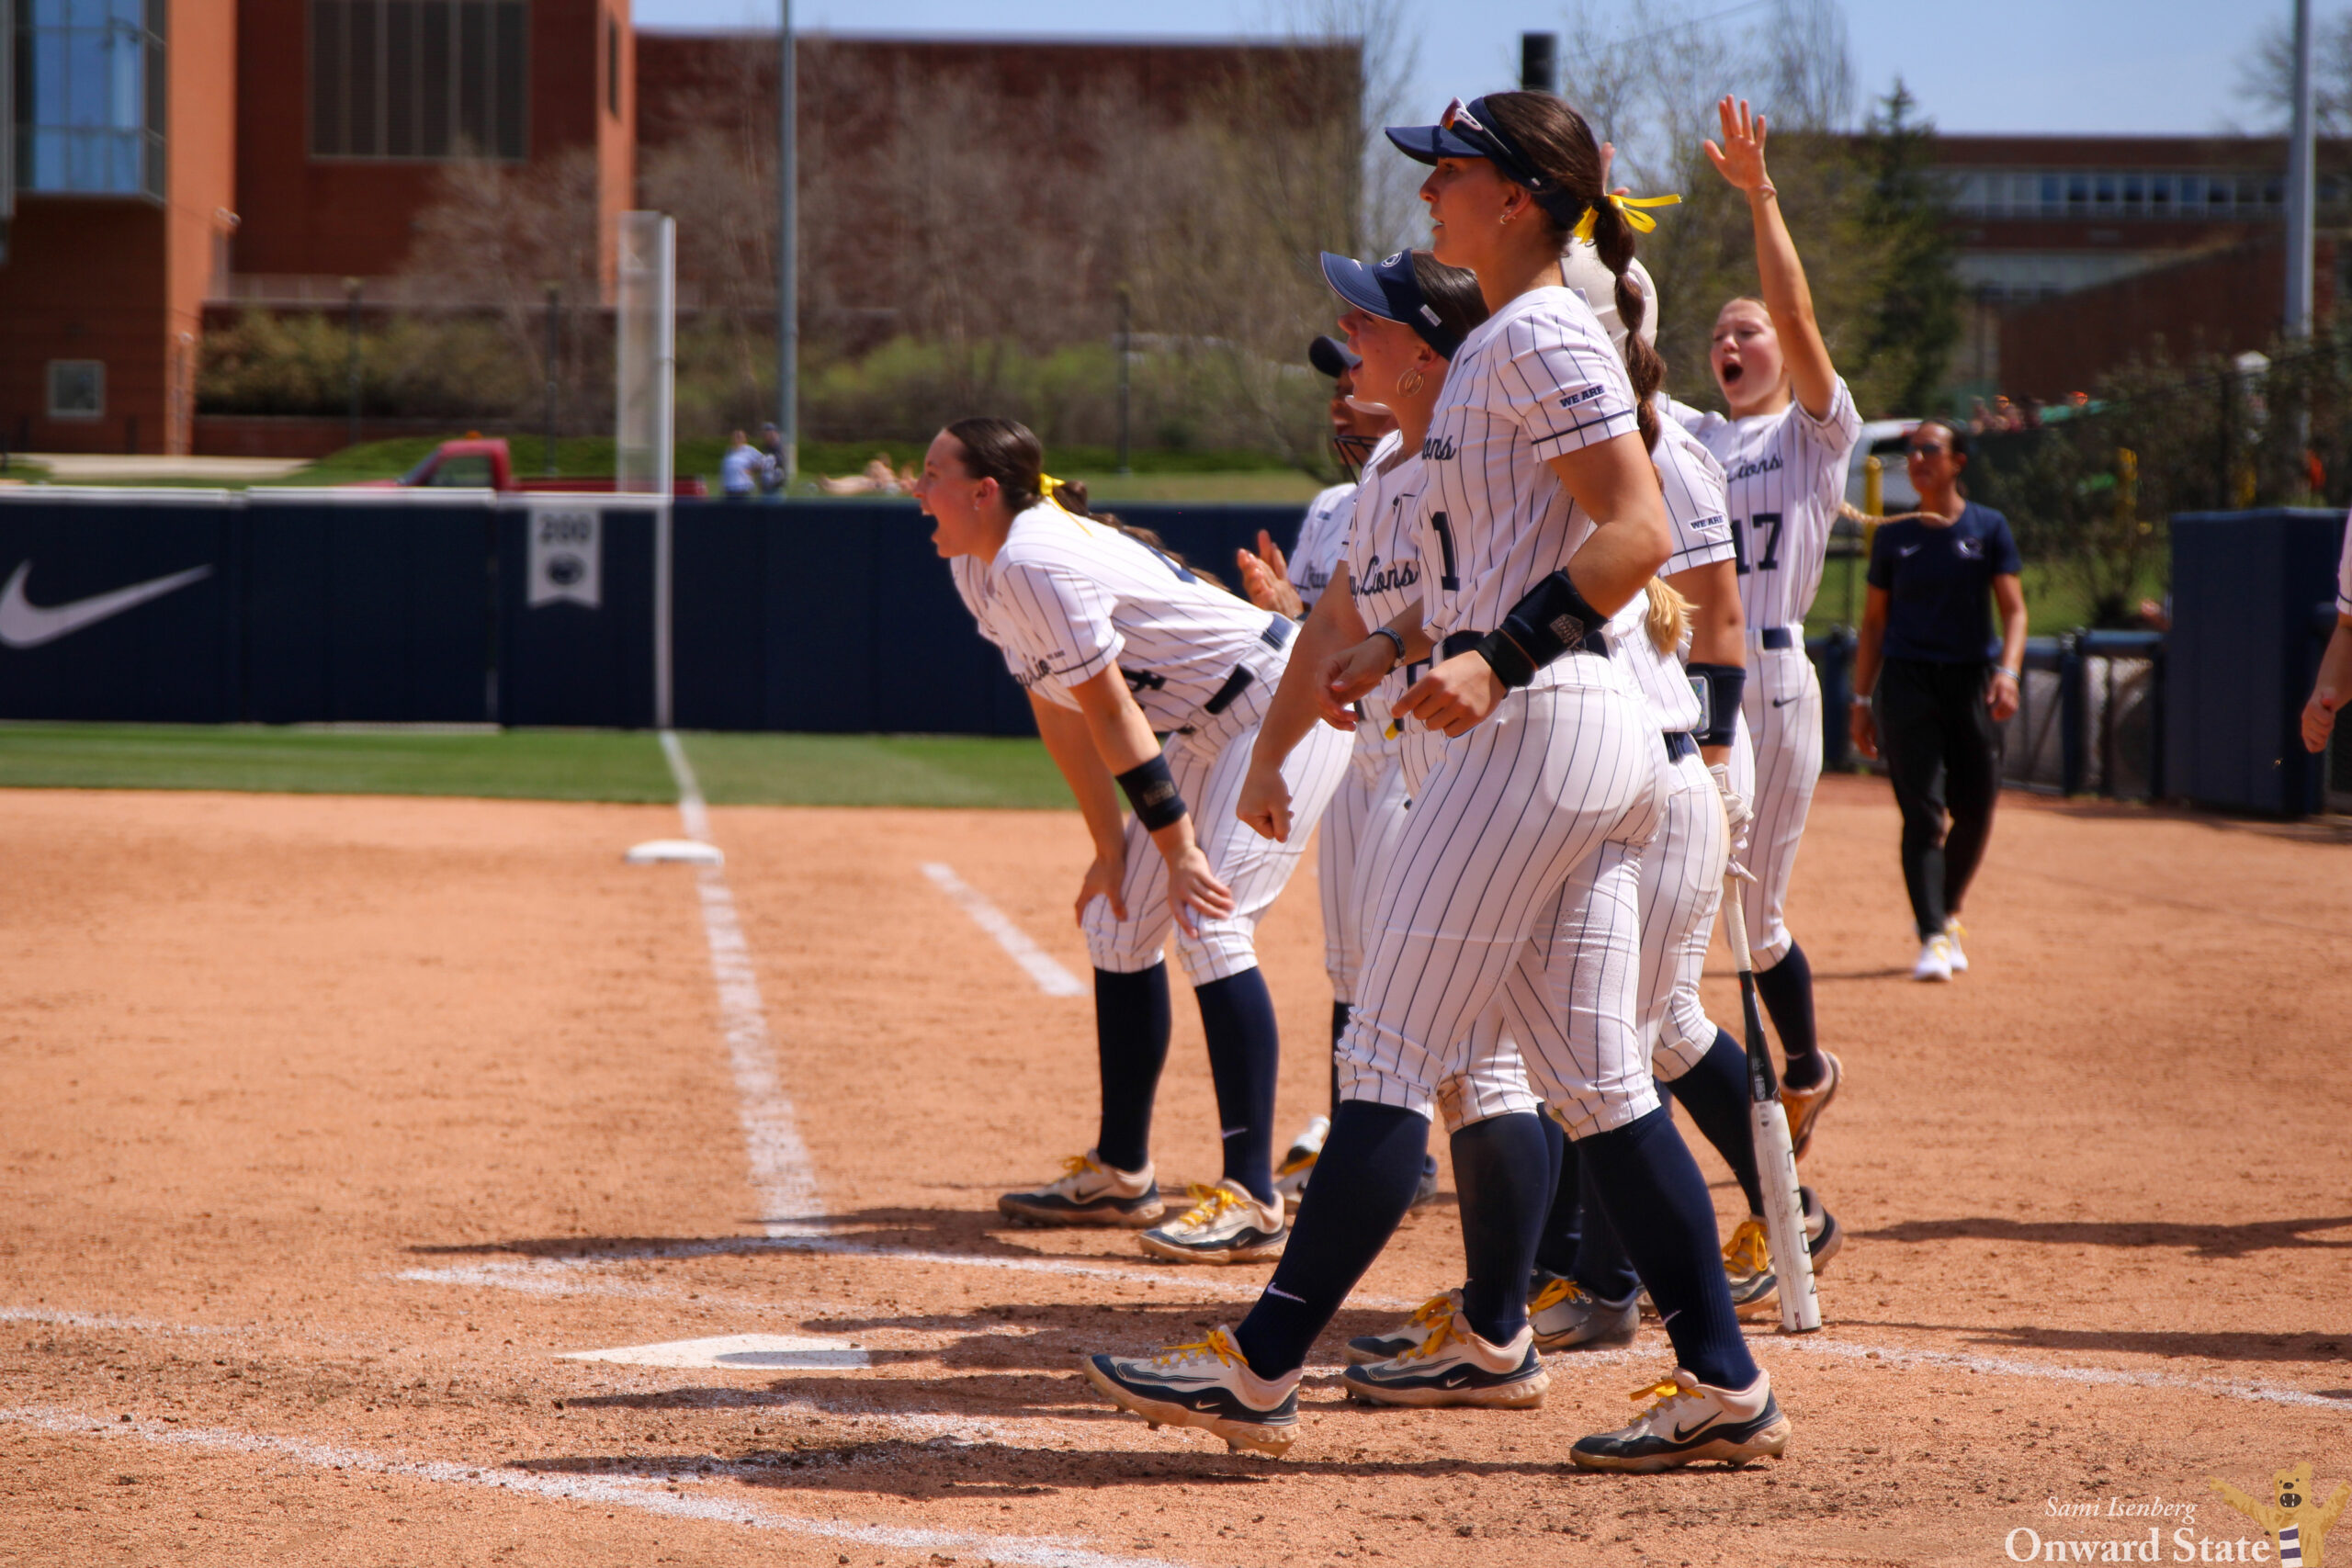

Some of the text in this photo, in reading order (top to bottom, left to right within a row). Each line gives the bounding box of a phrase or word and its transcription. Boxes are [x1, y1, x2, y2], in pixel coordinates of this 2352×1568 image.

[1560, 386, 1604, 408] WE ARE
[539, 514, 591, 545] 200
[1690, 515, 1724, 529] WE ARE
[1732, 513, 1782, 576] 17
[1361, 556, 1419, 595] Lions
